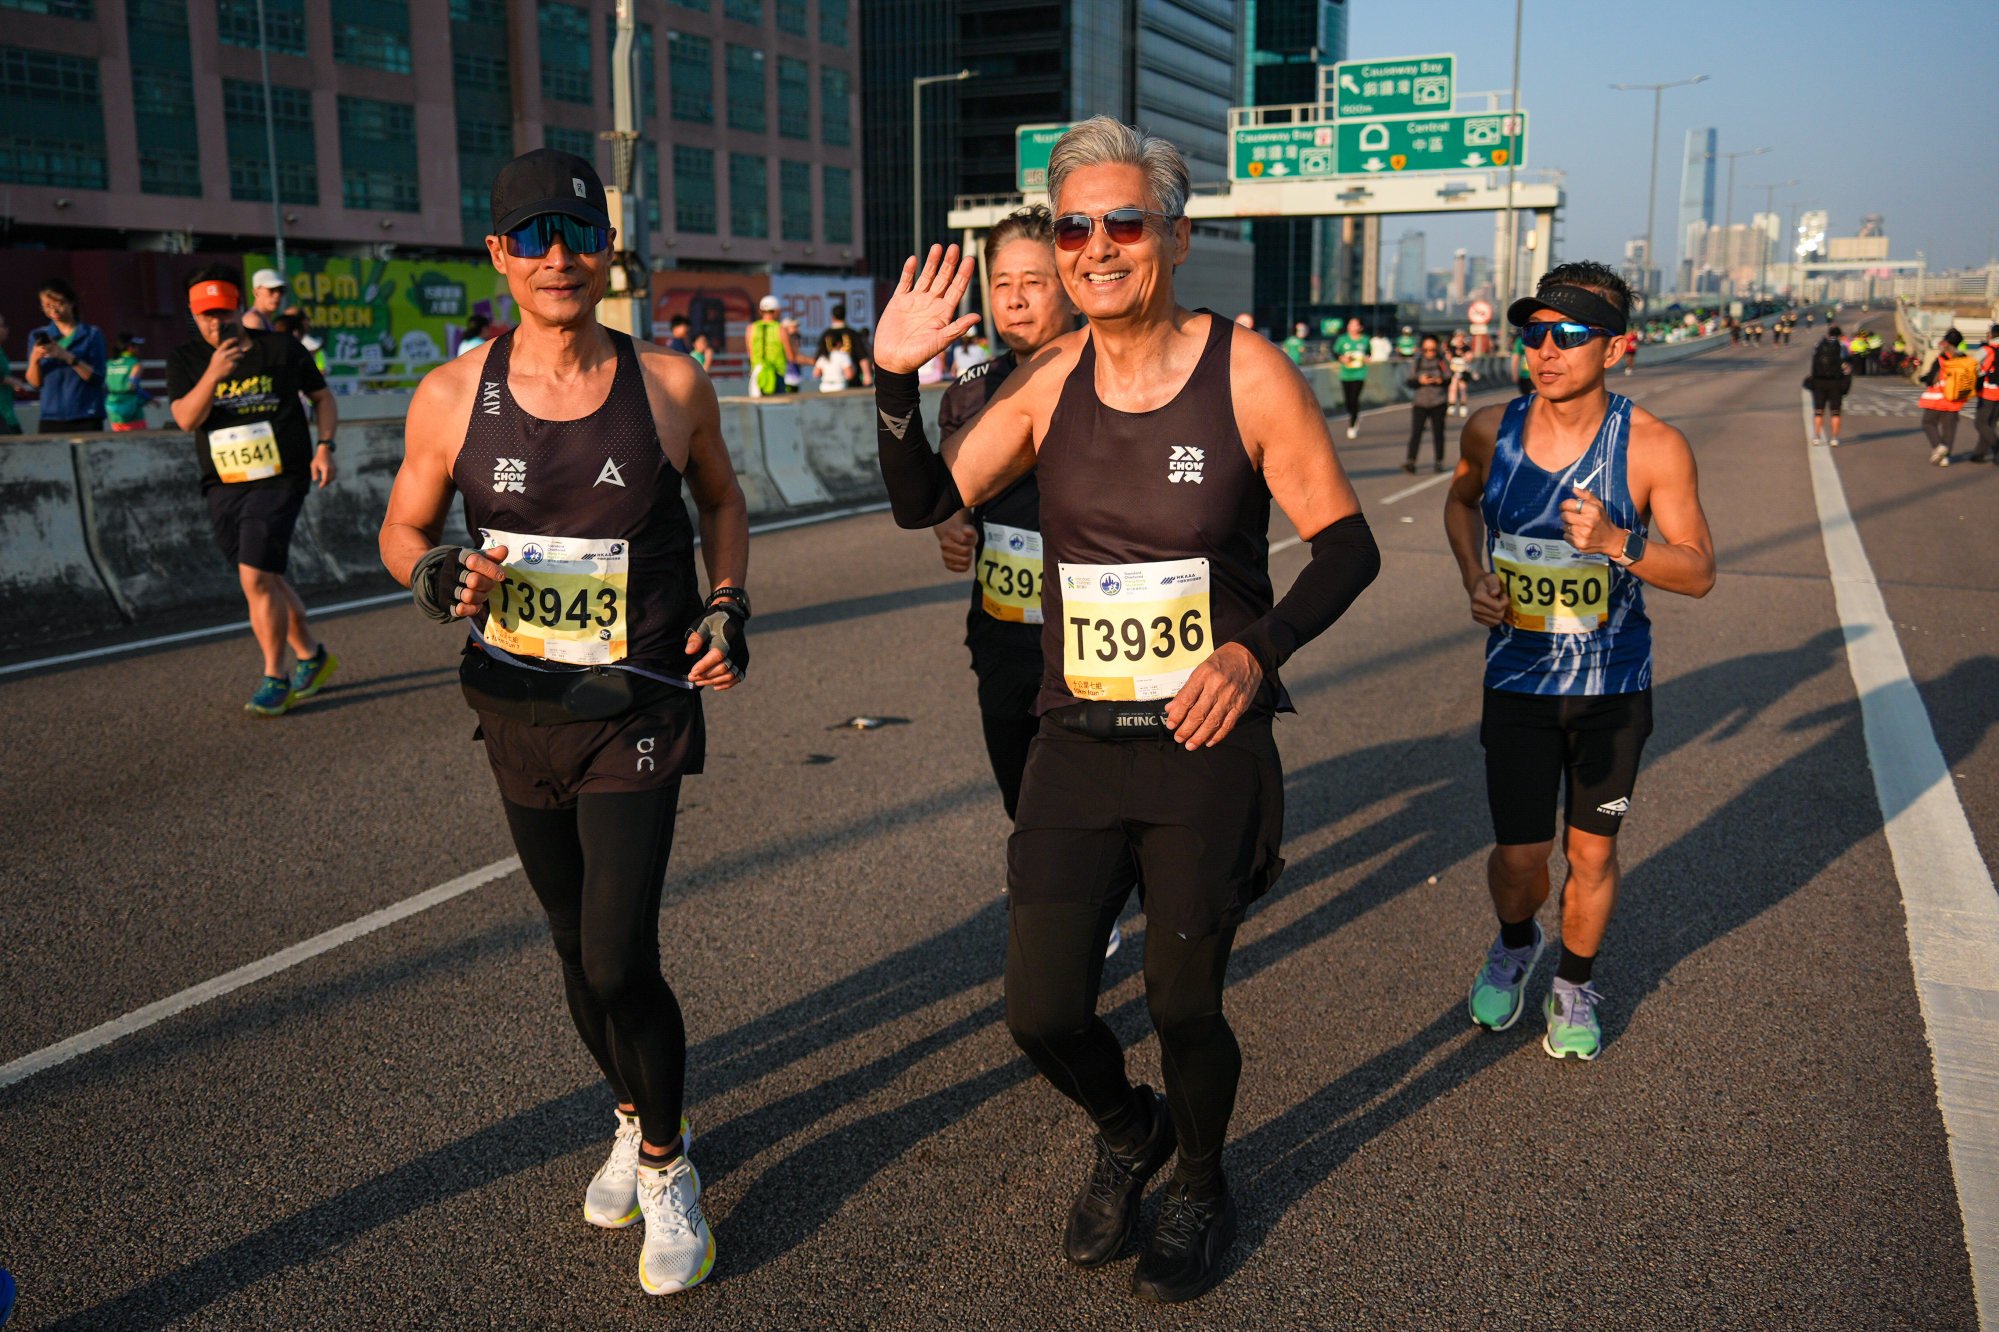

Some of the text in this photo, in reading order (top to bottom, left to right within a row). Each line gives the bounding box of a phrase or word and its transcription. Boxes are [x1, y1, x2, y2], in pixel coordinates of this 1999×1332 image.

[1407, 122, 1449, 133] Central
[294, 272, 359, 303] apm
[959, 363, 989, 385] AKIV
[483, 381, 500, 415] AKIV
[216, 443, 274, 468] T1541
[1169, 461, 1204, 471] CHOW
[494, 472, 526, 482] CHOW
[1500, 567, 1602, 608] T3950
[501, 578, 618, 628] T3943
[1070, 609, 1204, 662] T3936
[1597, 807, 1616, 817] NIKE
